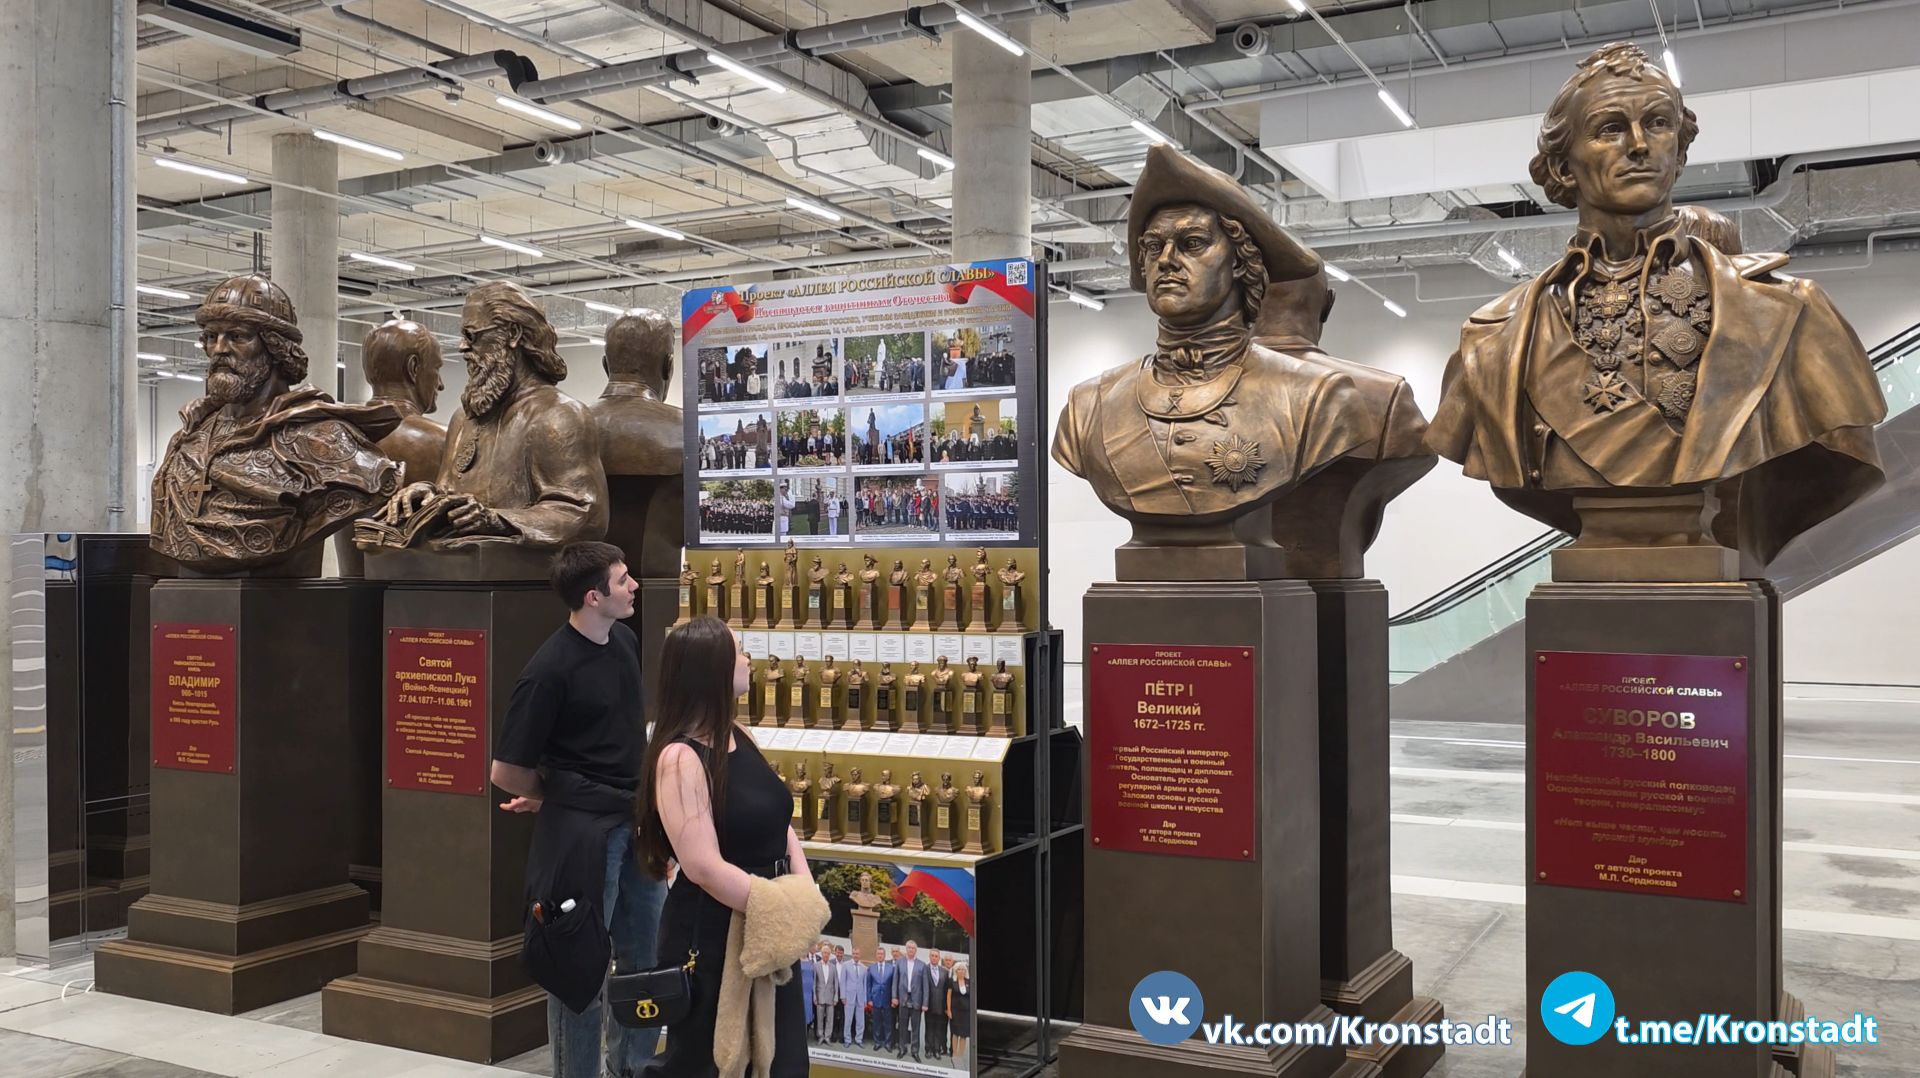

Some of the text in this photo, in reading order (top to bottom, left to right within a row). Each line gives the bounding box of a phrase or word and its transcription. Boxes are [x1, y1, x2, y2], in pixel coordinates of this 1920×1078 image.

[739, 266, 995, 304] Проект «АЛЛЕЯ РОССИЙСКОЙ СЛАВЫ»
[419, 656, 452, 668] Святой
[1107, 658, 1232, 668] «АЛЛЕЯ РОССИЙСКОЙ СЛАВЫ»
[168, 675, 221, 688] ВЛАДИМИР
[395, 671, 477, 685] архиепископ Лука
[1622, 676, 1657, 685] ПРОЕКТ
[402, 682, 469, 696] (Войно-Ясенецкий)
[1144, 680, 1194, 697] ПЁТР I
[1602, 683, 1674, 695] РОССИЙСКОЙ
[1676, 687, 1723, 698] СЛАВЫ»
[1137, 700, 1202, 716] Великий
[1133, 718, 1206, 732] 1672–1725 гг.
[1584, 707, 1696, 730] СУВОРОВ
[1635, 732, 1729, 749] Васильевич
[1140, 745, 1185, 755] Российский
[1186, 748, 1232, 759] император.
[1115, 753, 1182, 765] Государственный
[1190, 758, 1225, 767] военный
[1141, 765, 1187, 775] полководец
[1194, 768, 1234, 777] дипломат.
[1131, 773, 1209, 785] Основатель русской
[1118, 783, 1162, 792] регулярной
[1163, 785, 1188, 794] армии
[1195, 786, 1223, 795] флота.
[1623, 778, 1667, 790] русский
[1669, 782, 1737, 795] полководец
[1122, 791, 1155, 800] Заложил
[1187, 795, 1219, 805] русской
[1640, 790, 1684, 802] русской
[1150, 803, 1177, 811] школы
[1185, 806, 1224, 814] искусства
[1162, 820, 1177, 830] Дар
[1148, 828, 1172, 837] автора
[1173, 830, 1201, 839] проекта
[1158, 836, 1198, 846] Сердюкова
[1628, 854, 1648, 866] Дар
[1594, 863, 1683, 879] от автора проекта
[1599, 872, 1678, 888] М.Л. Сердюкова
